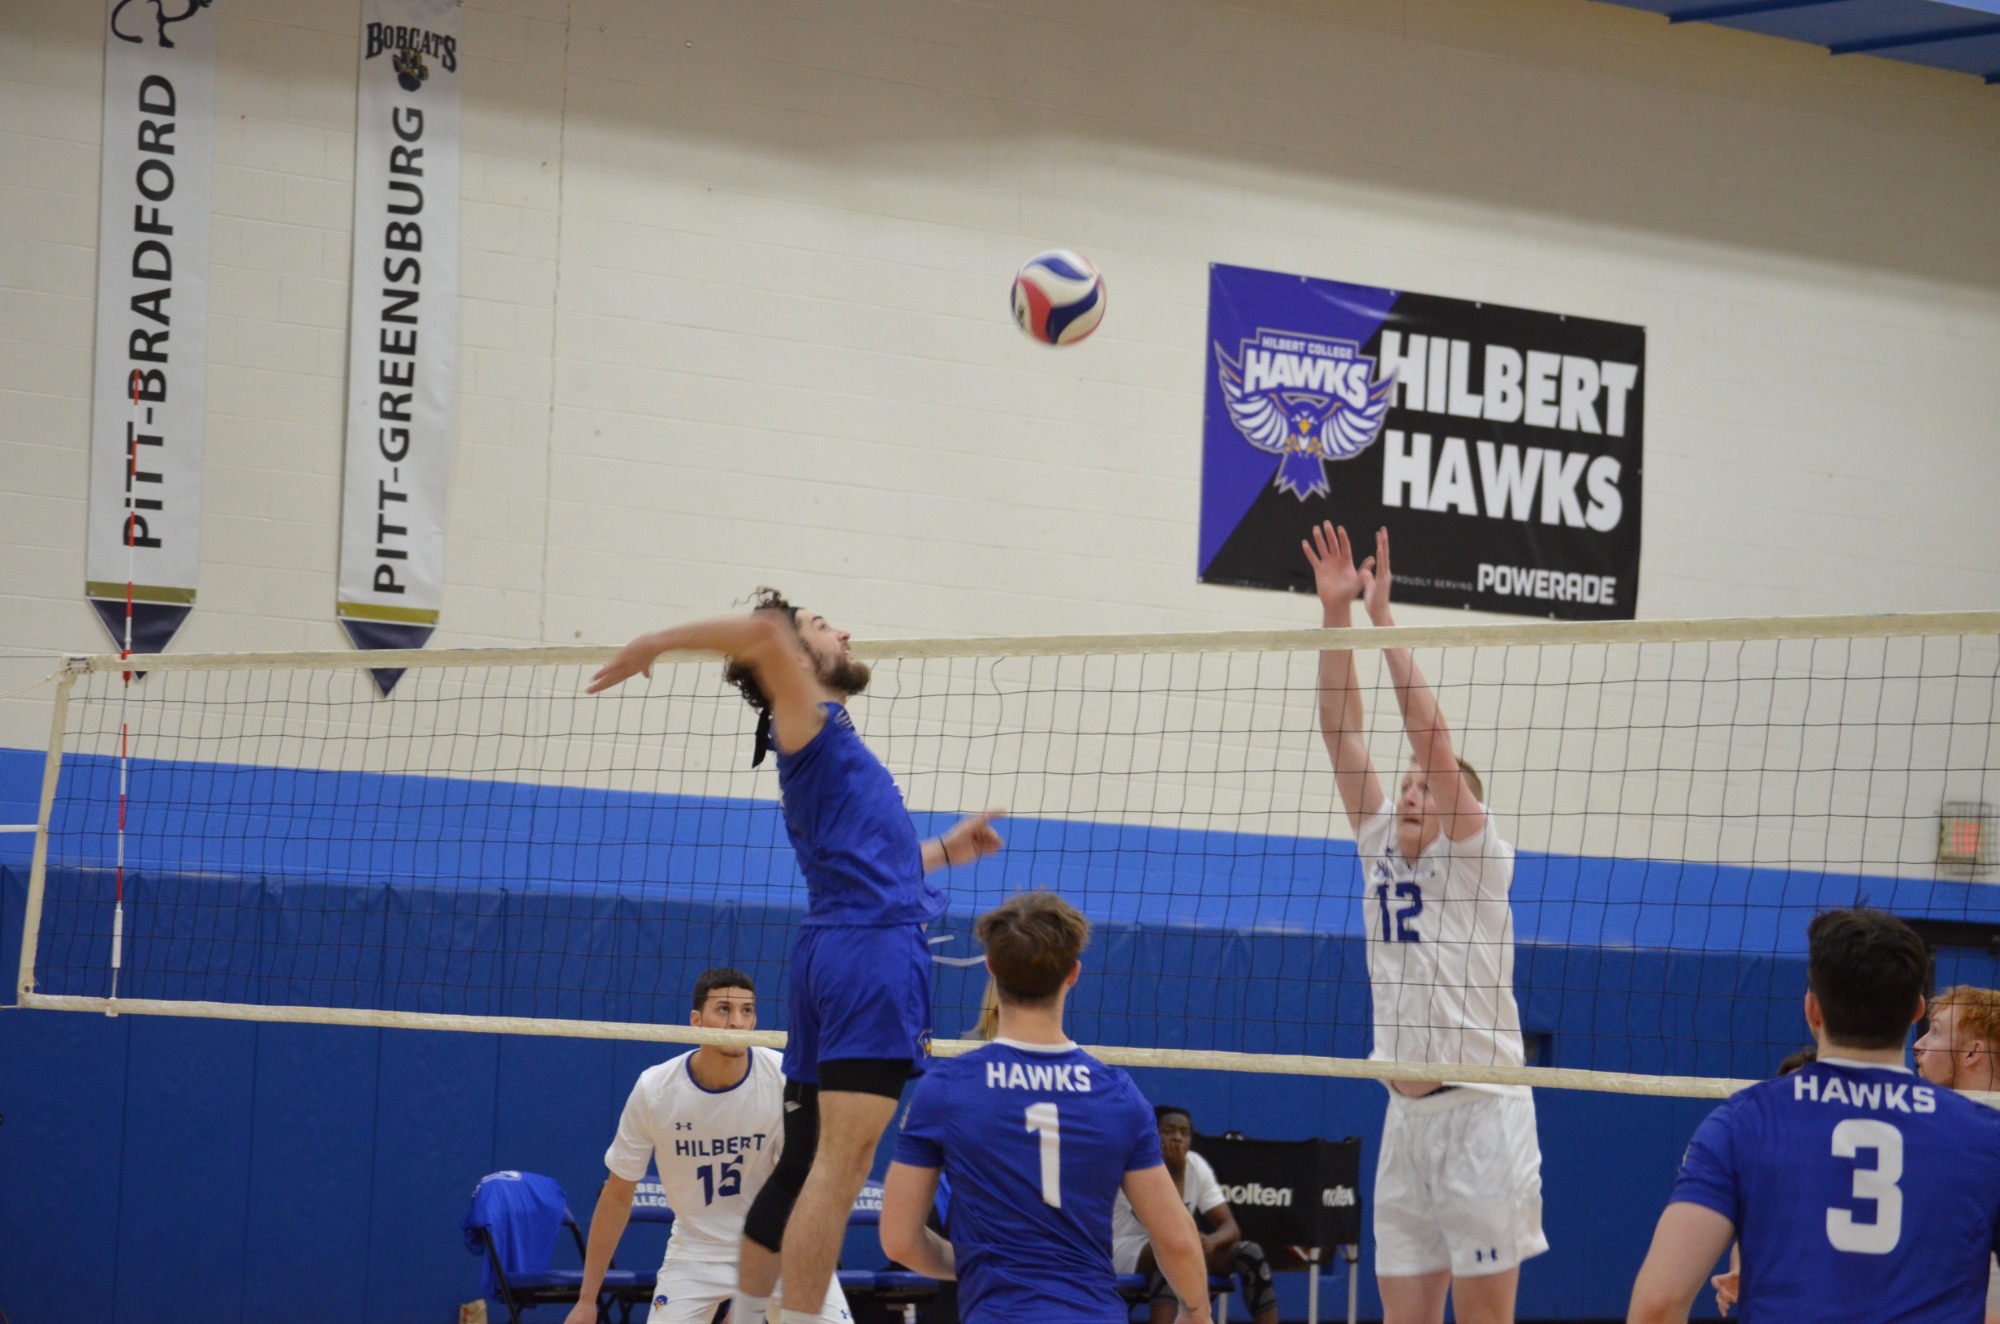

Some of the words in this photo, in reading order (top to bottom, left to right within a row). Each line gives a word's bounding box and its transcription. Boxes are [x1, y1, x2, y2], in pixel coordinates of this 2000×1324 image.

[365, 22, 457, 73] BOBCATS
[123, 75, 177, 548] PITT-BRADFORD
[373, 106, 424, 594] PITT-GREENSBURG
[1261, 336, 1306, 353] HILBERT
[1307, 342, 1354, 360] COLLEGE
[1244, 348, 1369, 410] HAWKS
[1379, 329, 1638, 437] HILBERT
[1382, 429, 1623, 532] HAWKS
[1391, 574, 1432, 587] PROUDLY
[1433, 579, 1473, 591] SERVING
[1477, 562, 1617, 605] POWERADE
[1375, 881, 1423, 944] 12
[986, 1060, 1092, 1092] HAWKS
[1793, 1075, 1937, 1113] HAWKS
[675, 1134, 766, 1157] HILBERT
[1024, 1102, 1061, 1208] 1
[696, 1155, 744, 1207] 15
[1826, 1118, 1903, 1255] 3
